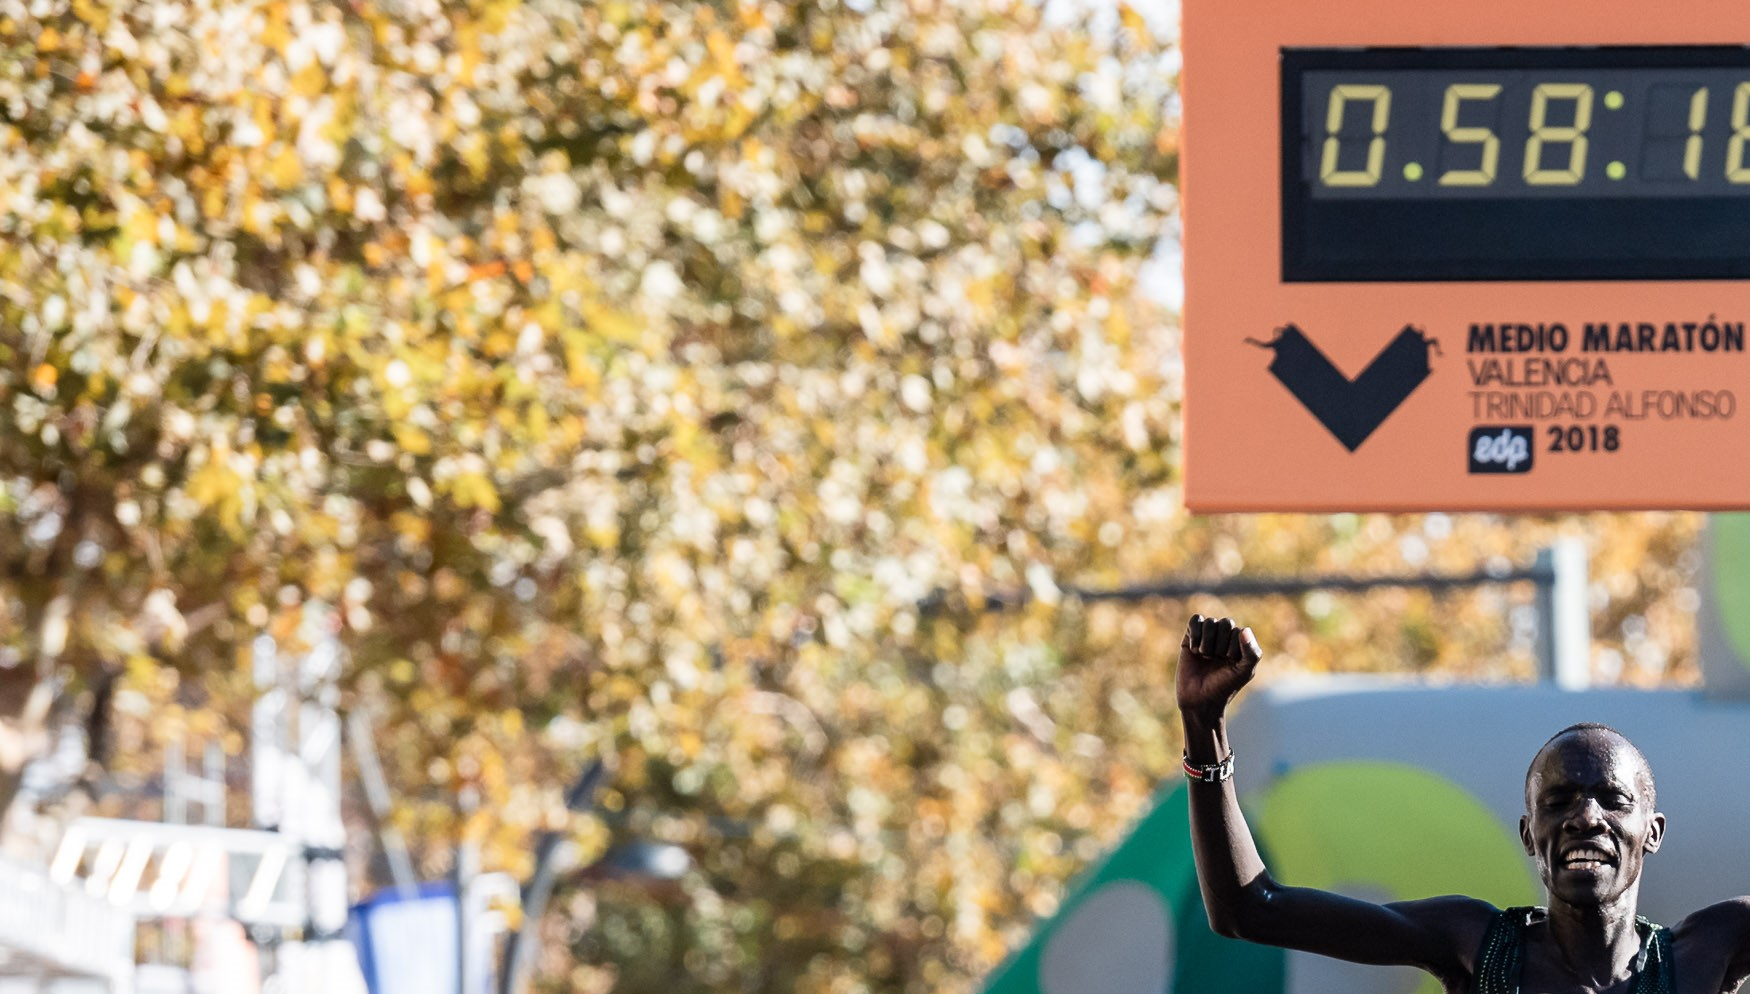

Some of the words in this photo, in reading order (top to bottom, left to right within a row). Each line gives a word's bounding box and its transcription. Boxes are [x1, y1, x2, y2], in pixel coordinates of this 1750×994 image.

[1467, 322, 1569, 353] MEDIO
[1582, 312, 1745, 353] MARATÓN
[1467, 358, 1615, 387] VALENCIA
[1467, 389, 1596, 420] TRINIDAD
[1602, 389, 1737, 420] ALFONSO
[1472, 427, 1530, 472] edp
[1547, 424, 1621, 452] 2018
